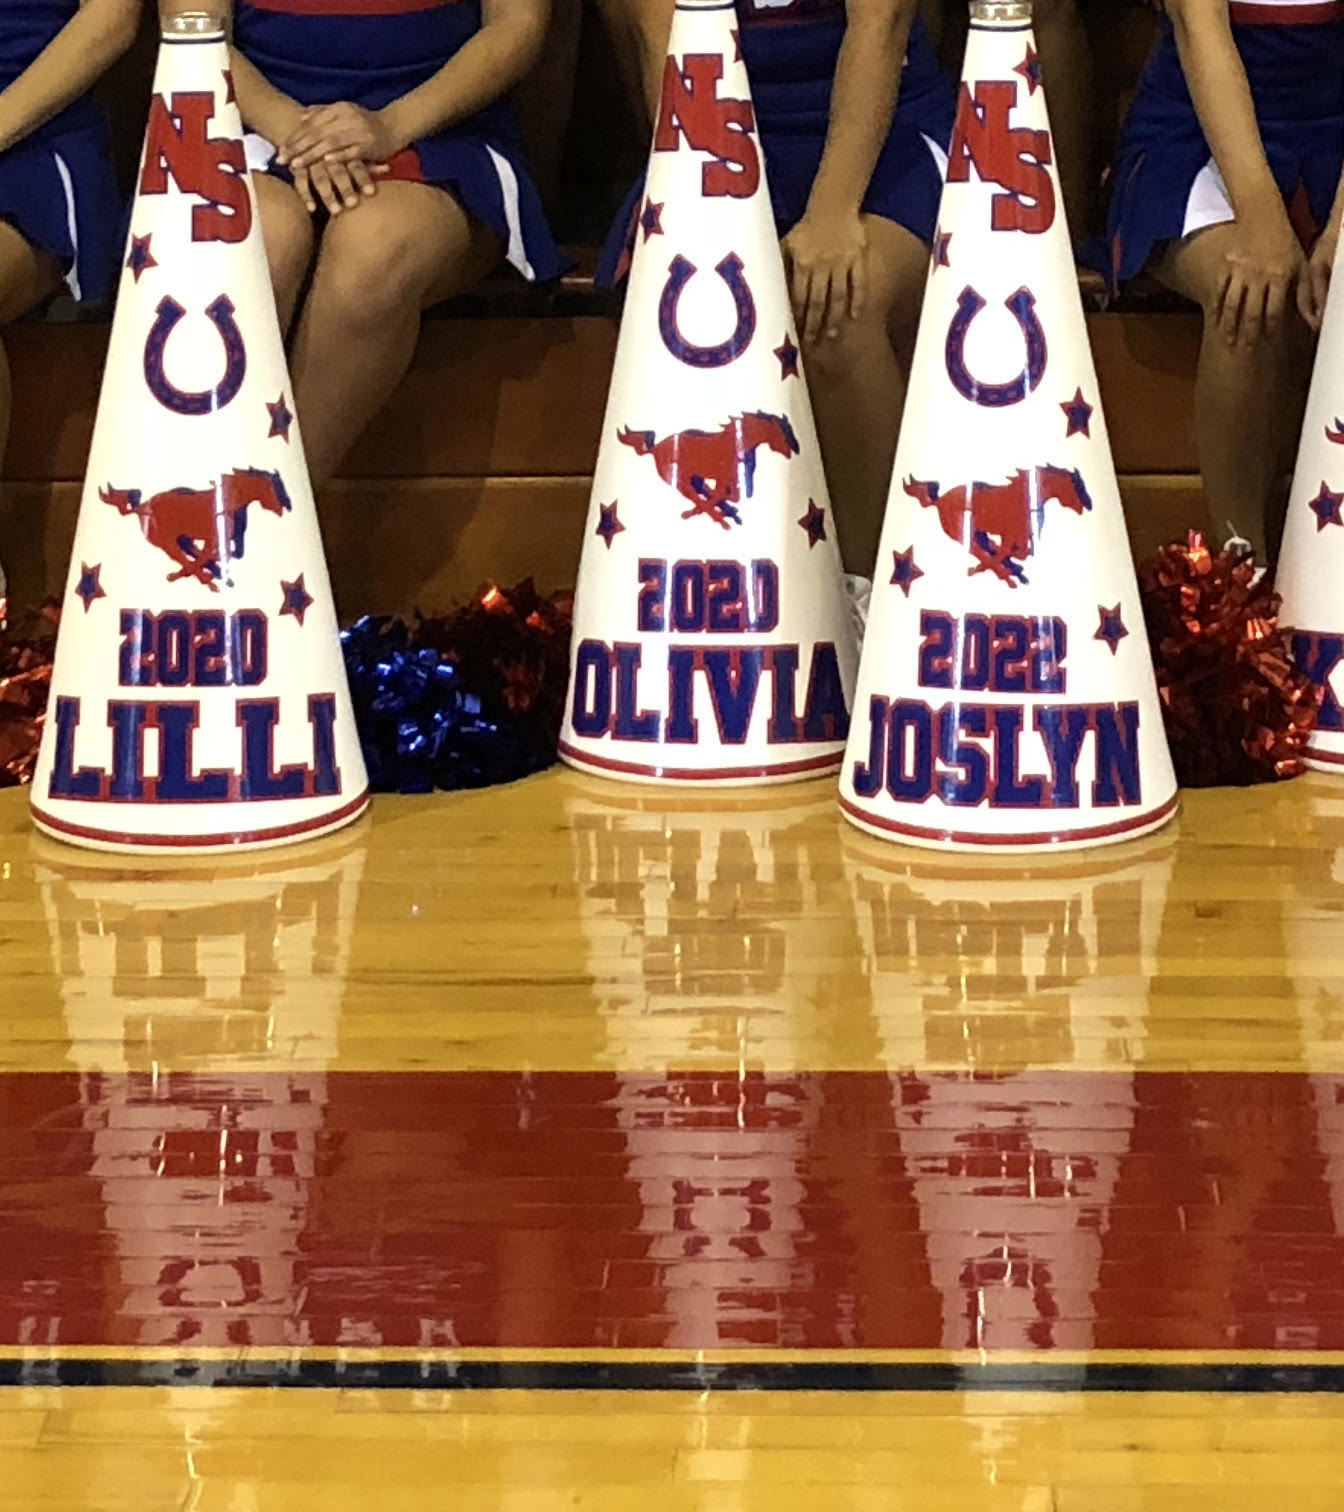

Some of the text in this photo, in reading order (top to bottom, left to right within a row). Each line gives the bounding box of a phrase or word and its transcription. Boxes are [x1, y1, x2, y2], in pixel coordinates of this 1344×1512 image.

[138, 90, 254, 245] NS
[654, 51, 762, 200] NS
[944, 80, 1057, 236] NS
[117, 607, 269, 688] 2020
[636, 556, 780, 634] 2020
[919, 608, 1068, 695] 2022
[47, 691, 343, 805] LILLI
[570, 639, 851, 746] OLIVIA
[853, 695, 1143, 810] JOSLYN
